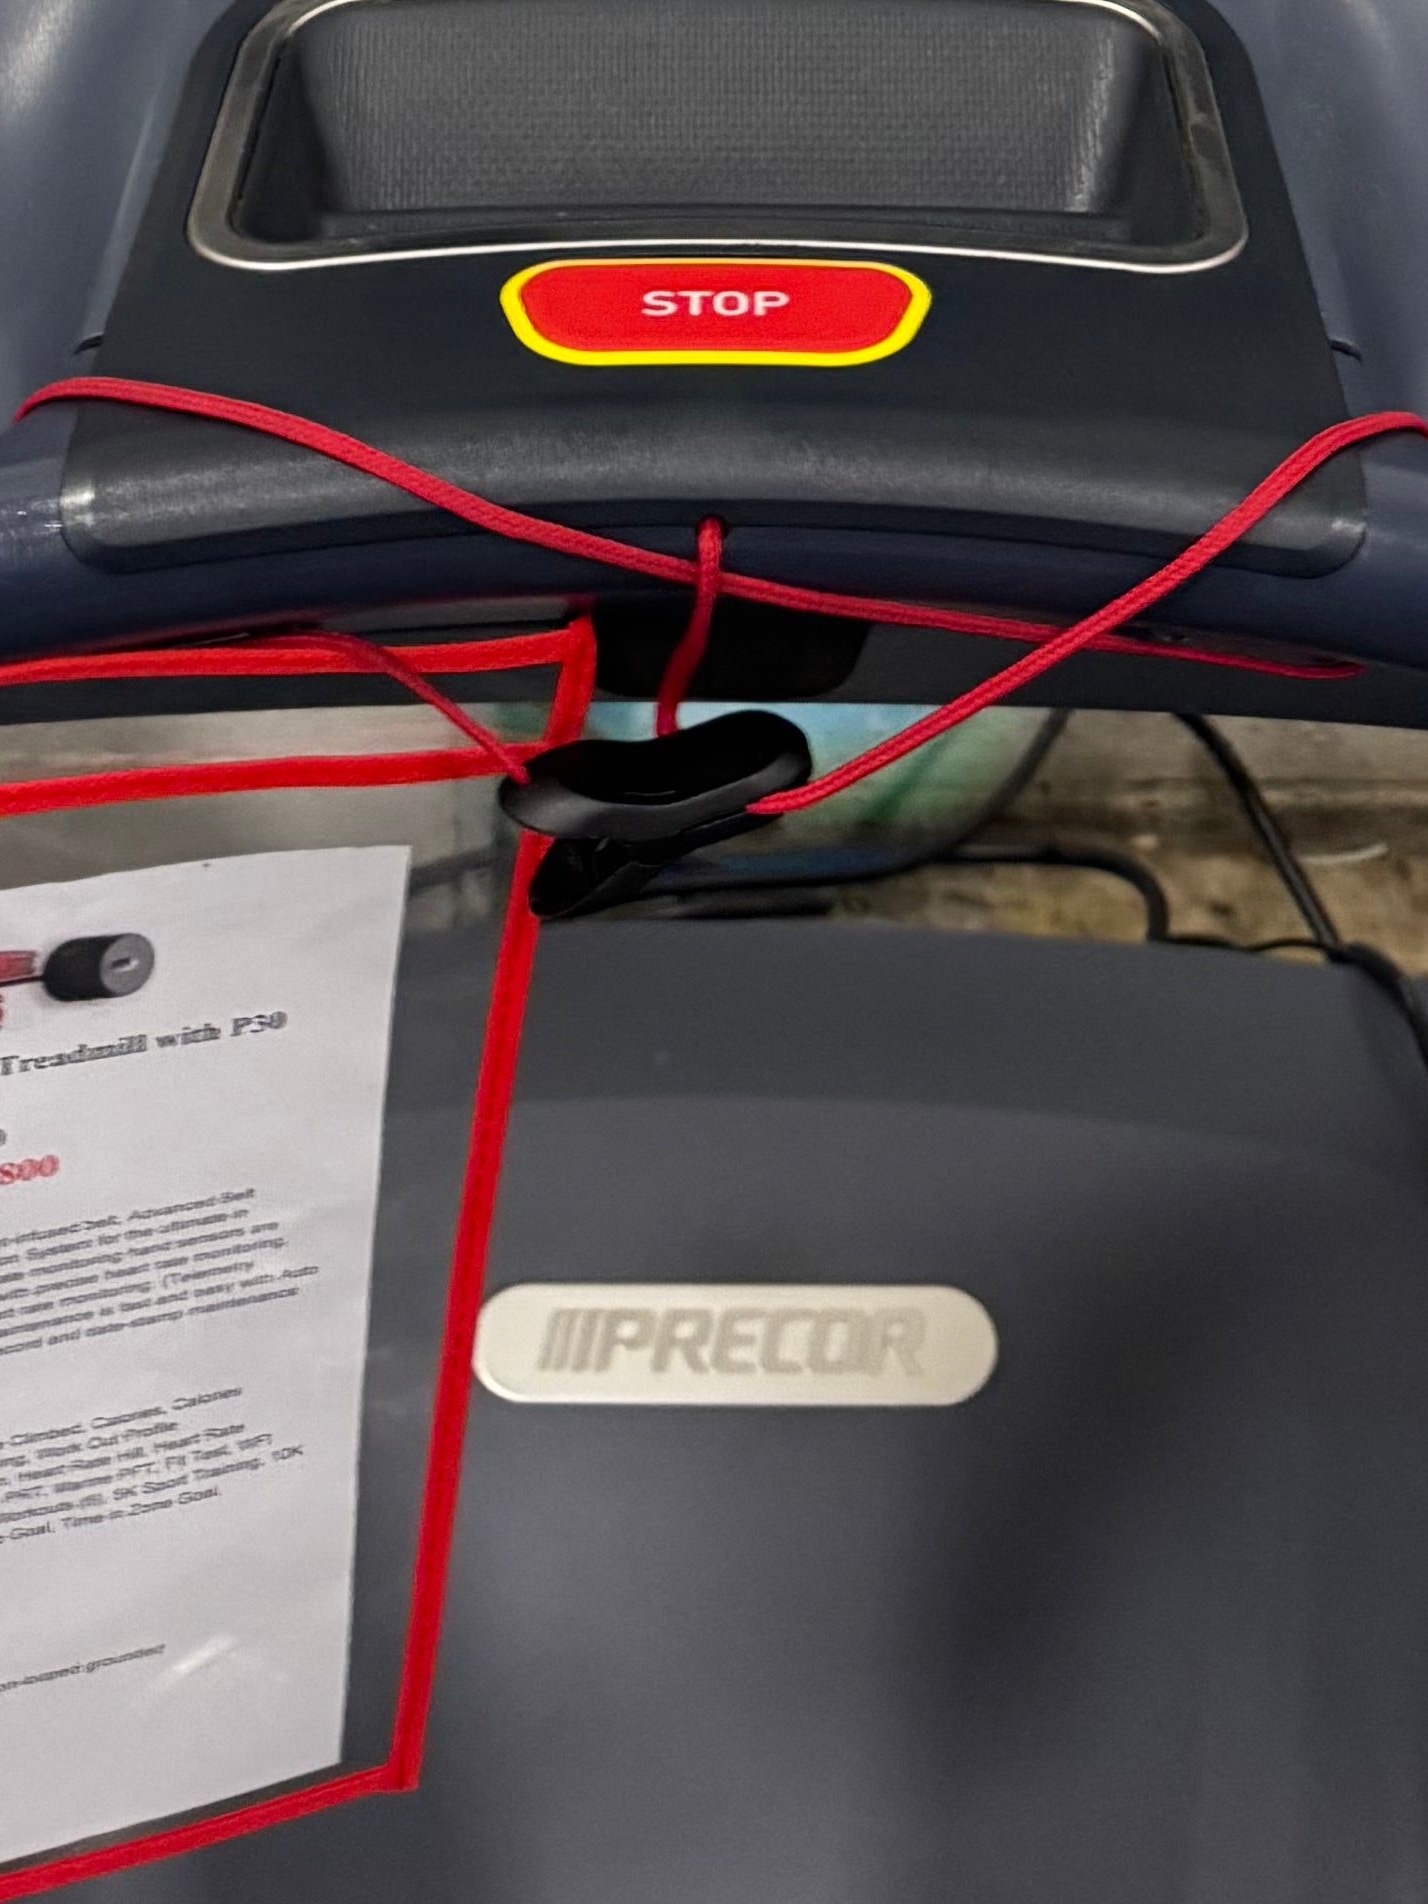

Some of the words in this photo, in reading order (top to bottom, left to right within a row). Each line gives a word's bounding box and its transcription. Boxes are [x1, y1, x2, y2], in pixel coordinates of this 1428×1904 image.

[641, 290, 790, 317] STOP
[156, 1023, 222, 1048] with
[594, 1306, 928, 1377] PRECOR
